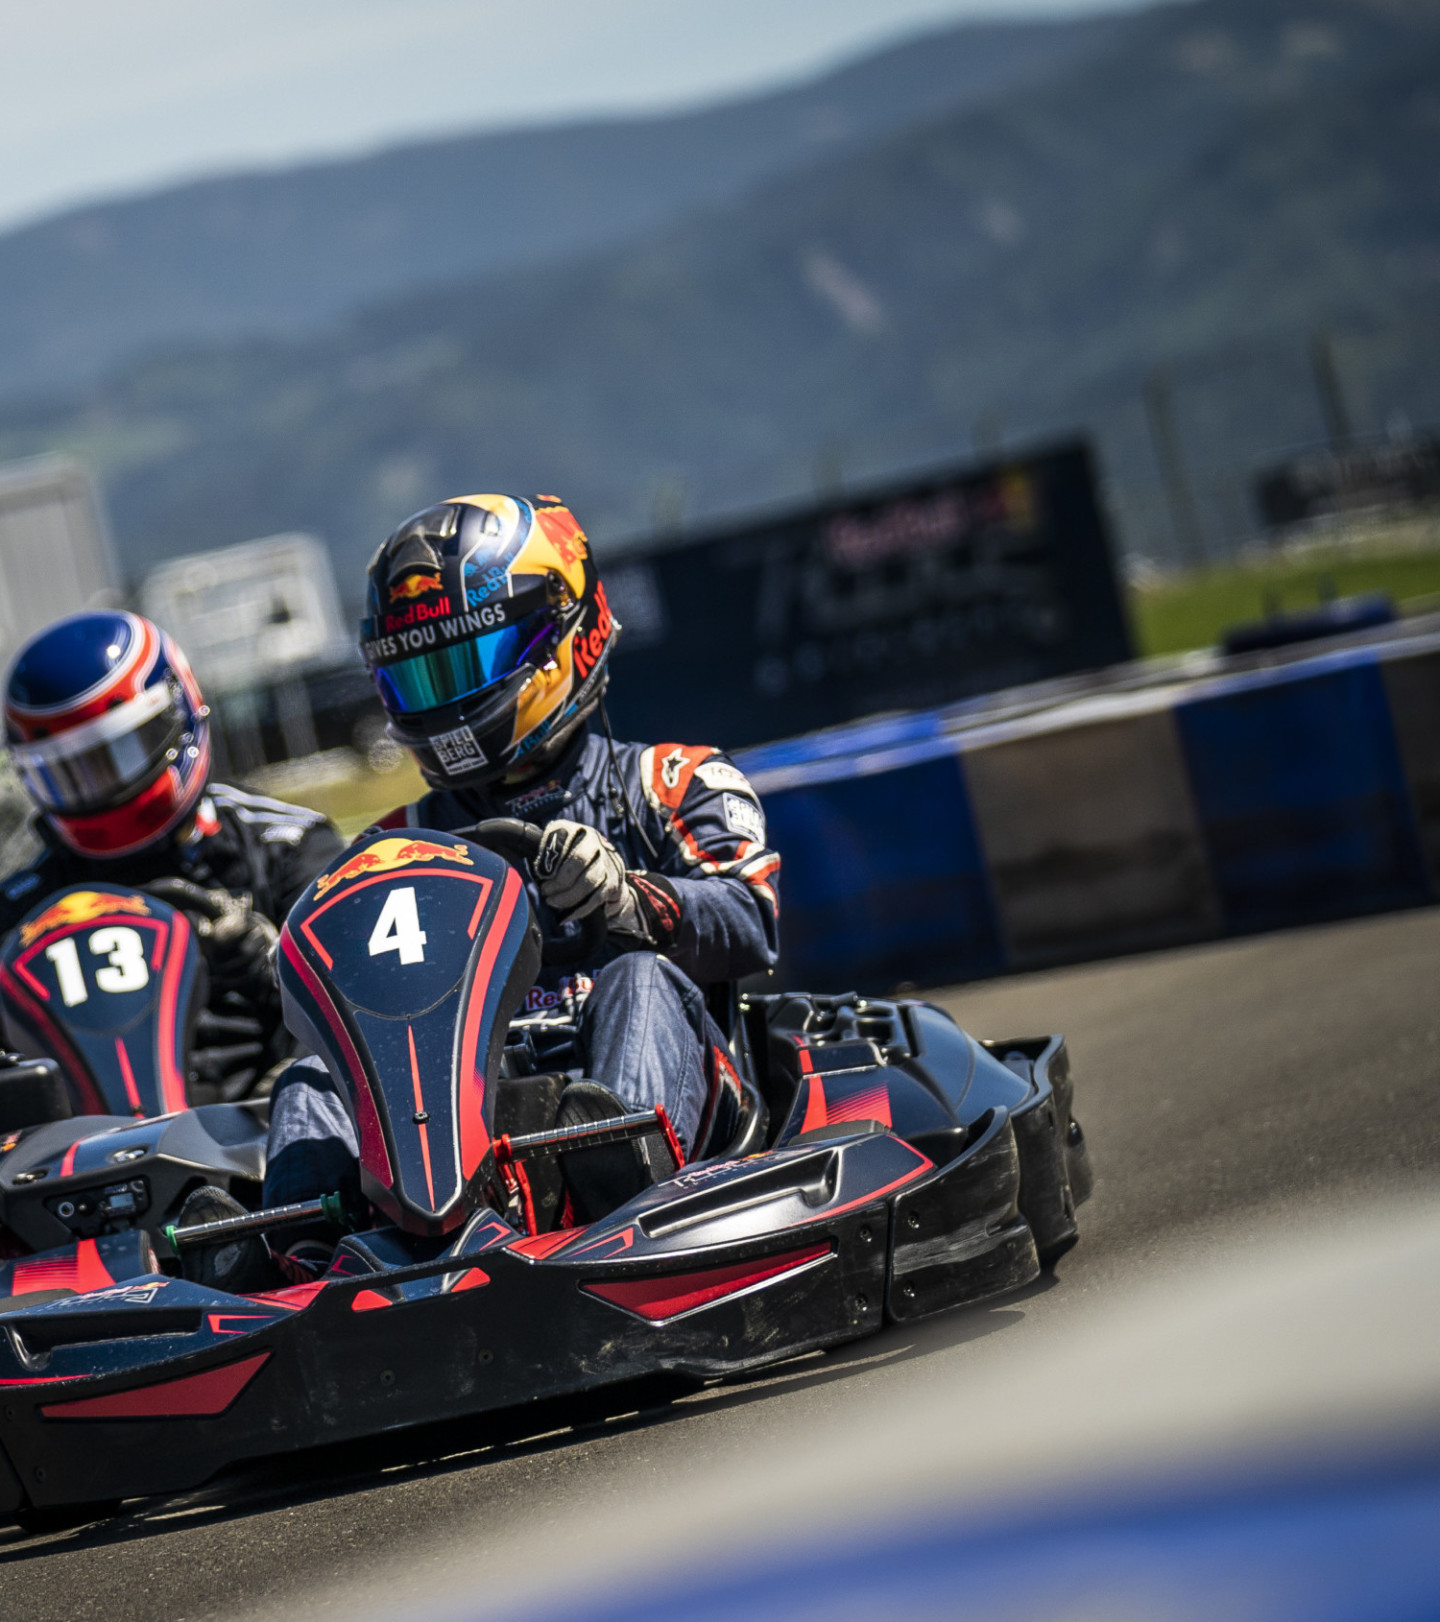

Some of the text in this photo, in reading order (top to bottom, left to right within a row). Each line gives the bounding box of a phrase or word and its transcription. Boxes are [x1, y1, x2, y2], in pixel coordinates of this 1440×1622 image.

[385, 596, 451, 633] Red Bull
[398, 625, 436, 651] YOU
[440, 603, 506, 640] WINGS
[368, 886, 427, 966] 4
[45, 926, 150, 1008] 13
